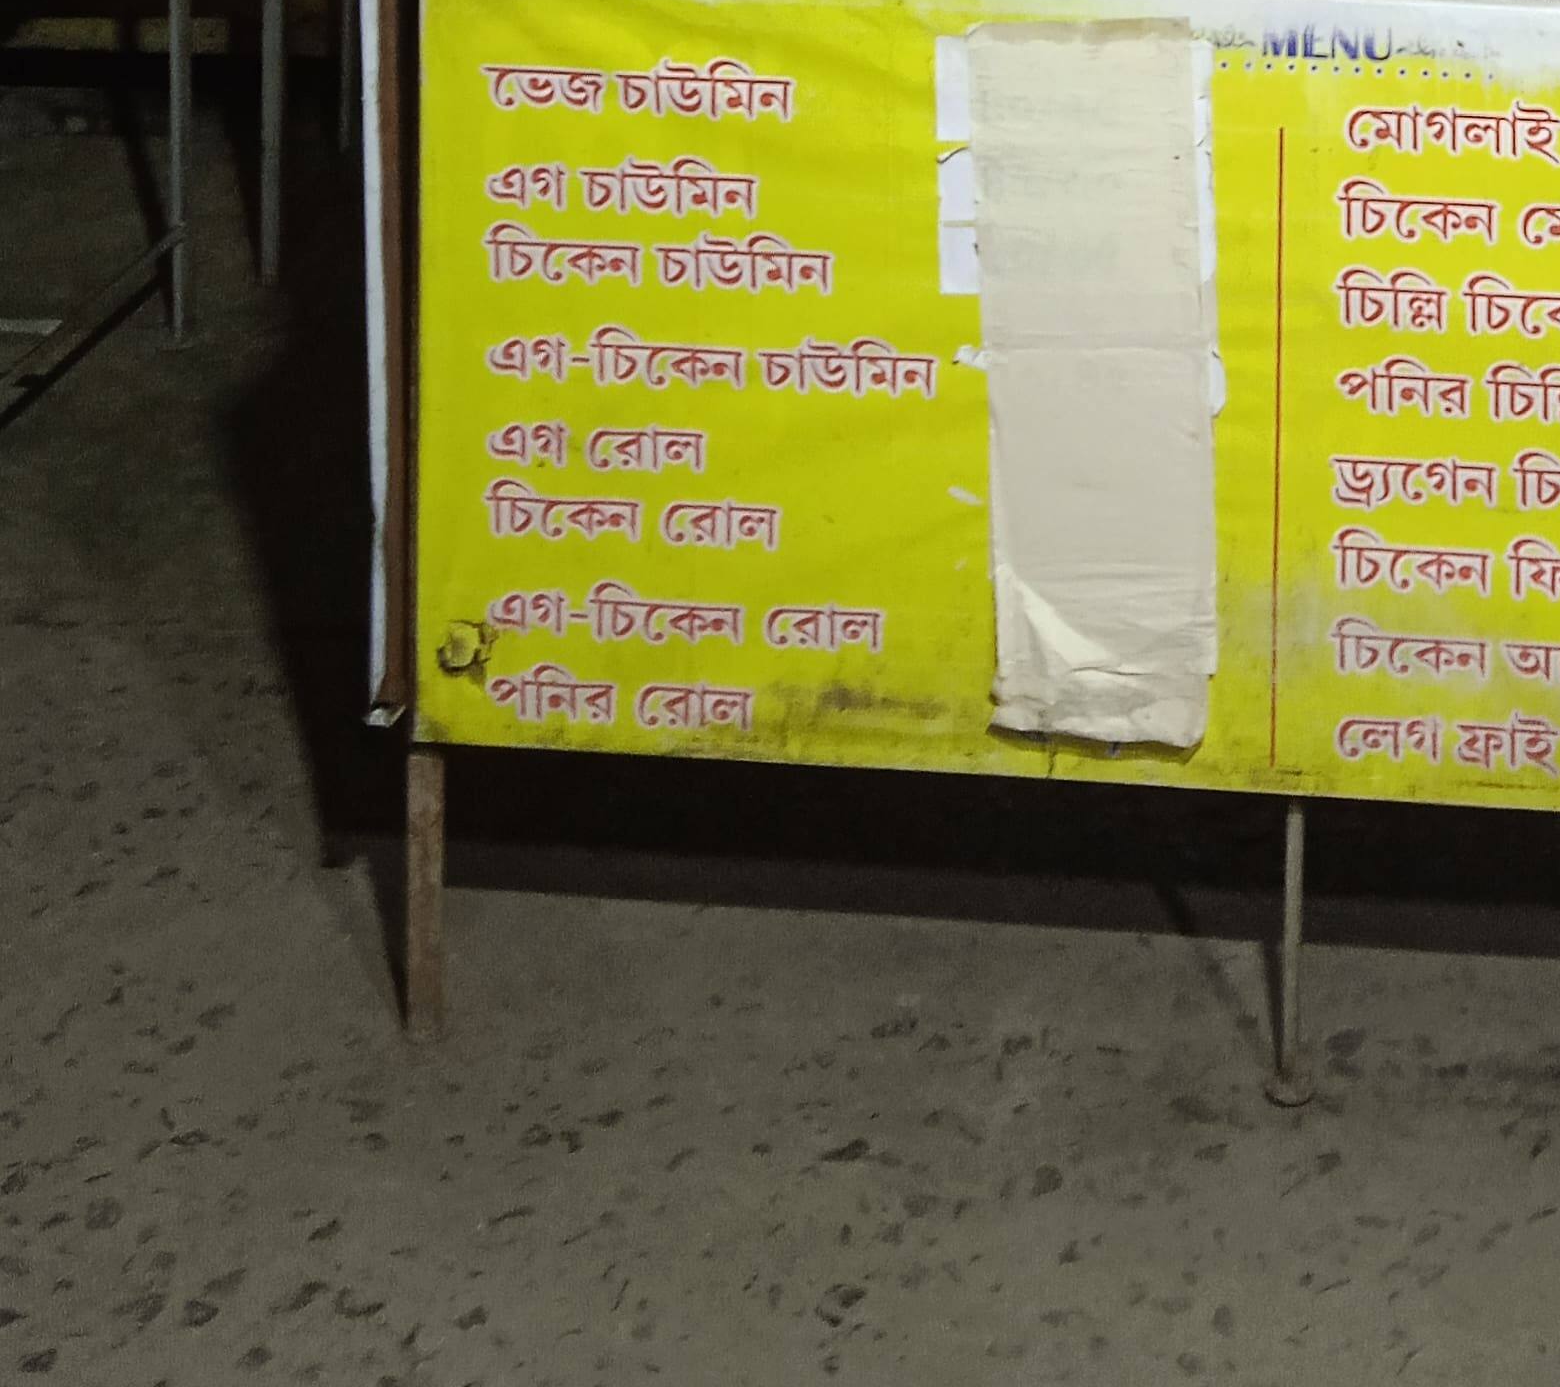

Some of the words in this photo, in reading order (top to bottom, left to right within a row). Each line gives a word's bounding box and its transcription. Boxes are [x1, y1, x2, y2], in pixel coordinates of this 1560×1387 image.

[1262, 24, 1392, 61] MENU
[483, 65, 603, 111] ভেজ
[618, 59, 793, 120] চাউমিন
[1348, 102, 1560, 164] মোগলাই
[488, 164, 565, 207] এগ
[581, 158, 757, 218] চাউমিন
[1338, 180, 1496, 241] চিকেন
[485, 224, 640, 284] চিকেন
[657, 232, 832, 294] চাউমিন
[1337, 268, 1446, 330] চিল্লি
[760, 339, 935, 397] চাউমিন
[1337, 357, 1468, 416] পনির
[489, 423, 565, 464] এগ
[588, 426, 704, 470] রোল
[485, 480, 638, 540] চিকেন
[664, 501, 777, 548] রোল
[1333, 528, 1490, 594] চিকেন
[766, 607, 882, 651] রোল
[1332, 617, 1487, 678] চিকেন
[489, 664, 615, 722] পনির
[638, 682, 753, 729] রোল
[1337, 718, 1440, 763] লেগ
[1456, 711, 1560, 776] ফ্রাই
